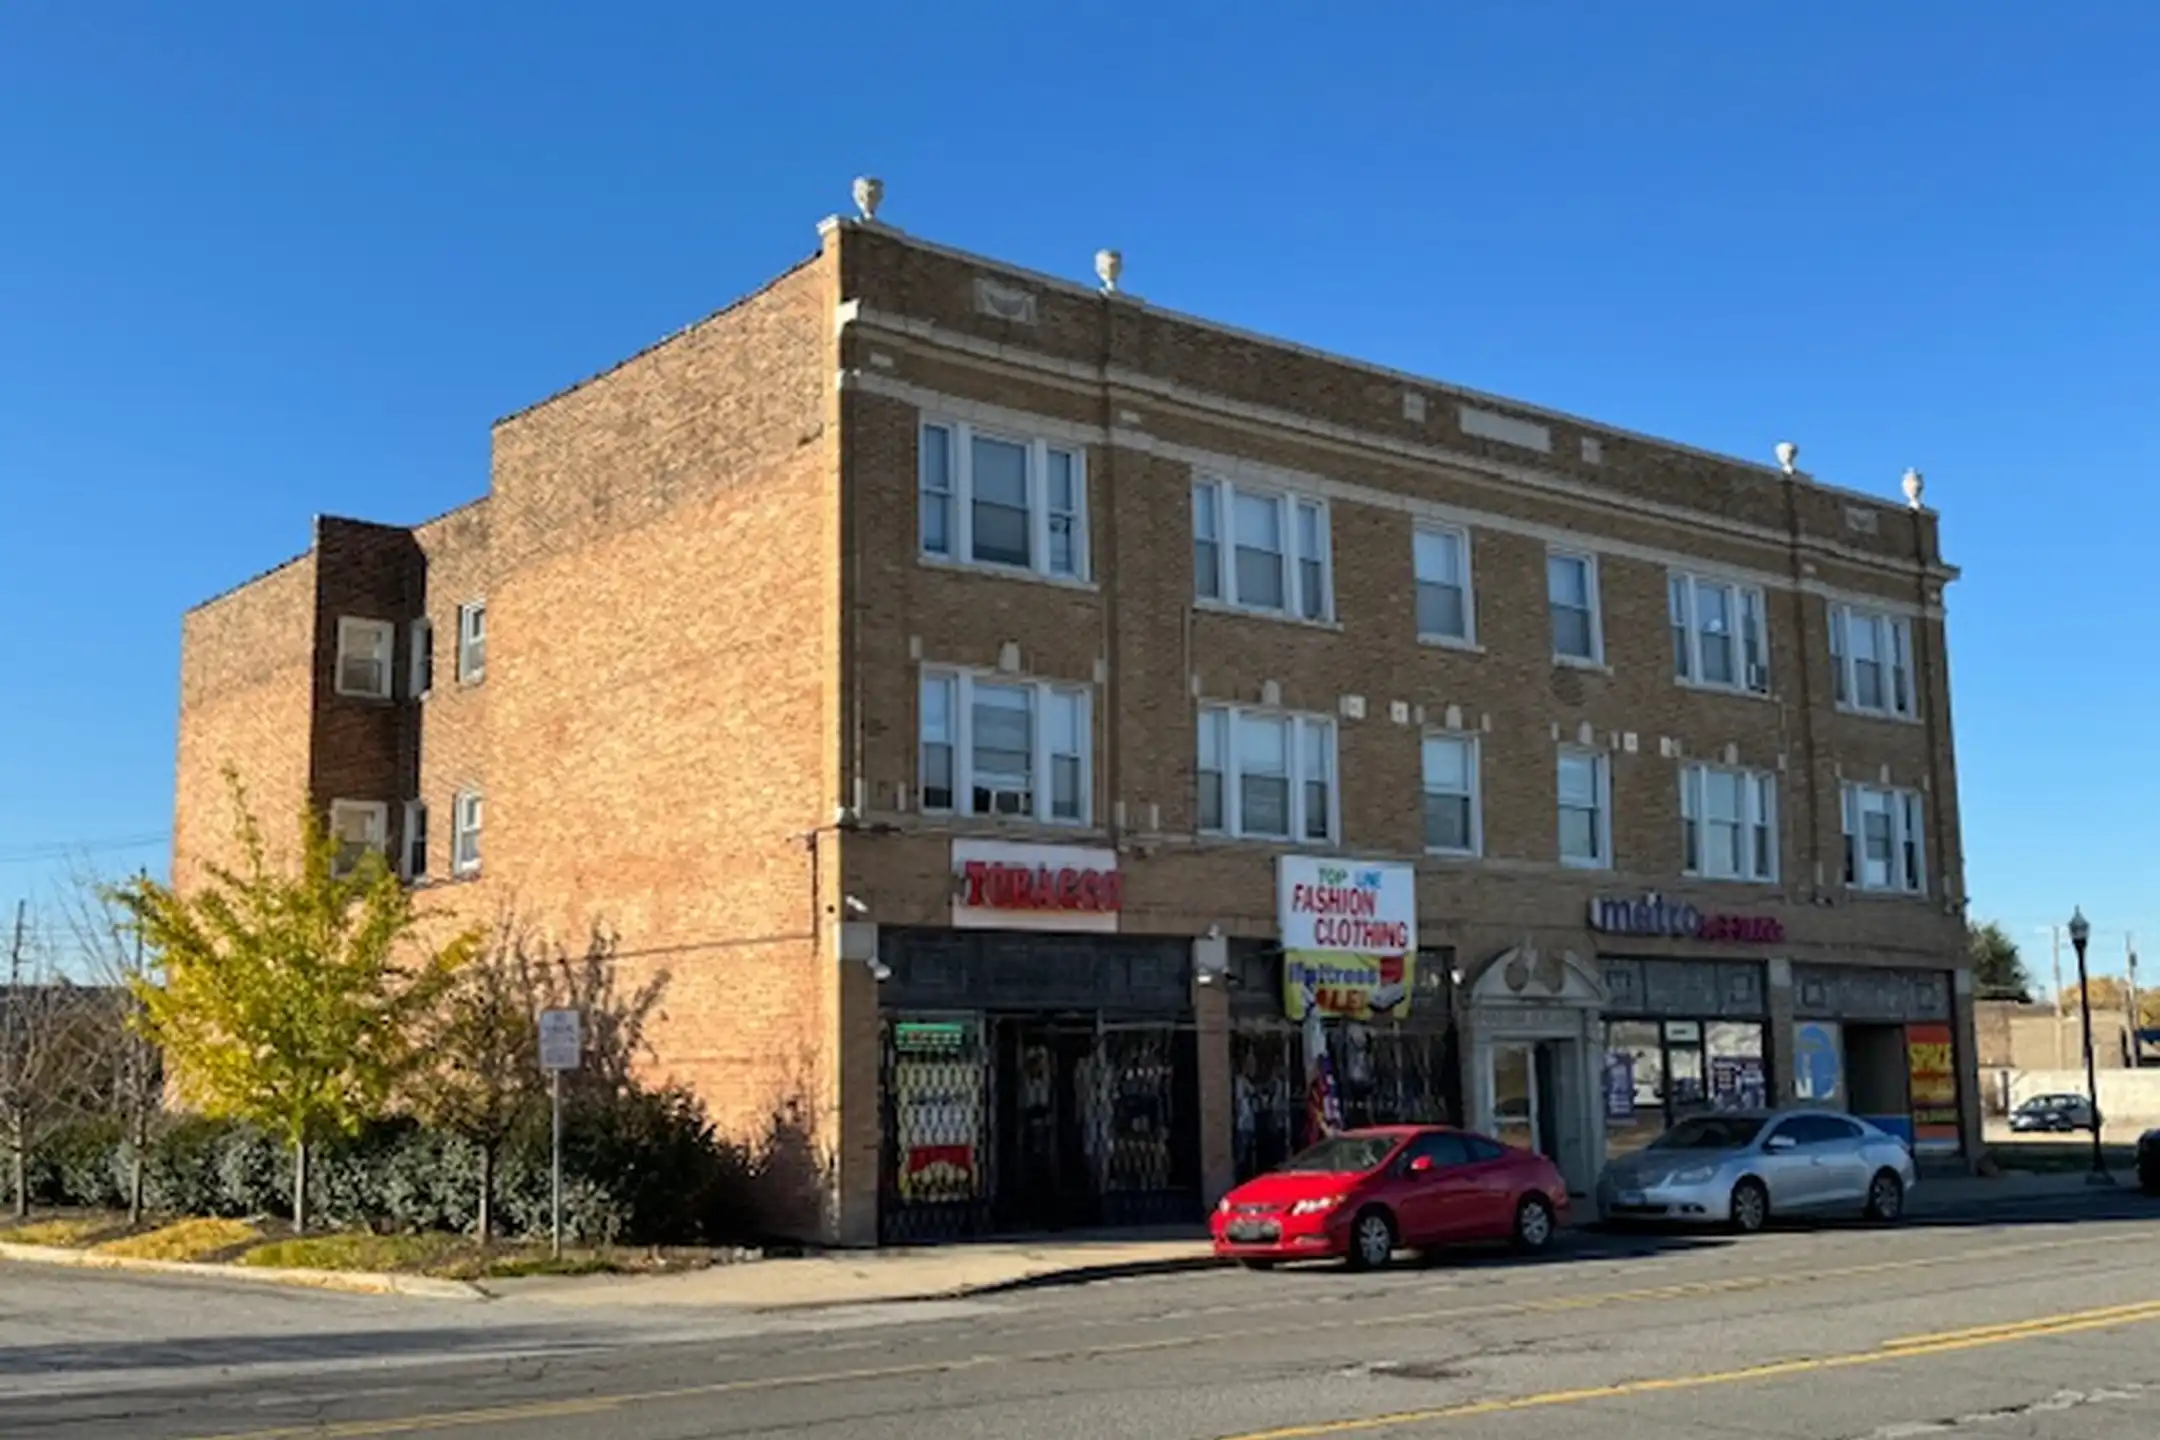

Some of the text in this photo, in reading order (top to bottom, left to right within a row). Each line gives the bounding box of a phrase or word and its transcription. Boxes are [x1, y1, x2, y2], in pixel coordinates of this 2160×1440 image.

[965, 861, 1123, 910] TOBACCO
[1318, 867, 1348, 884] TOP
[1291, 884, 1377, 917] FASHION
[1591, 893, 1699, 937] metro
[1314, 917, 1408, 947] CLOTHING
